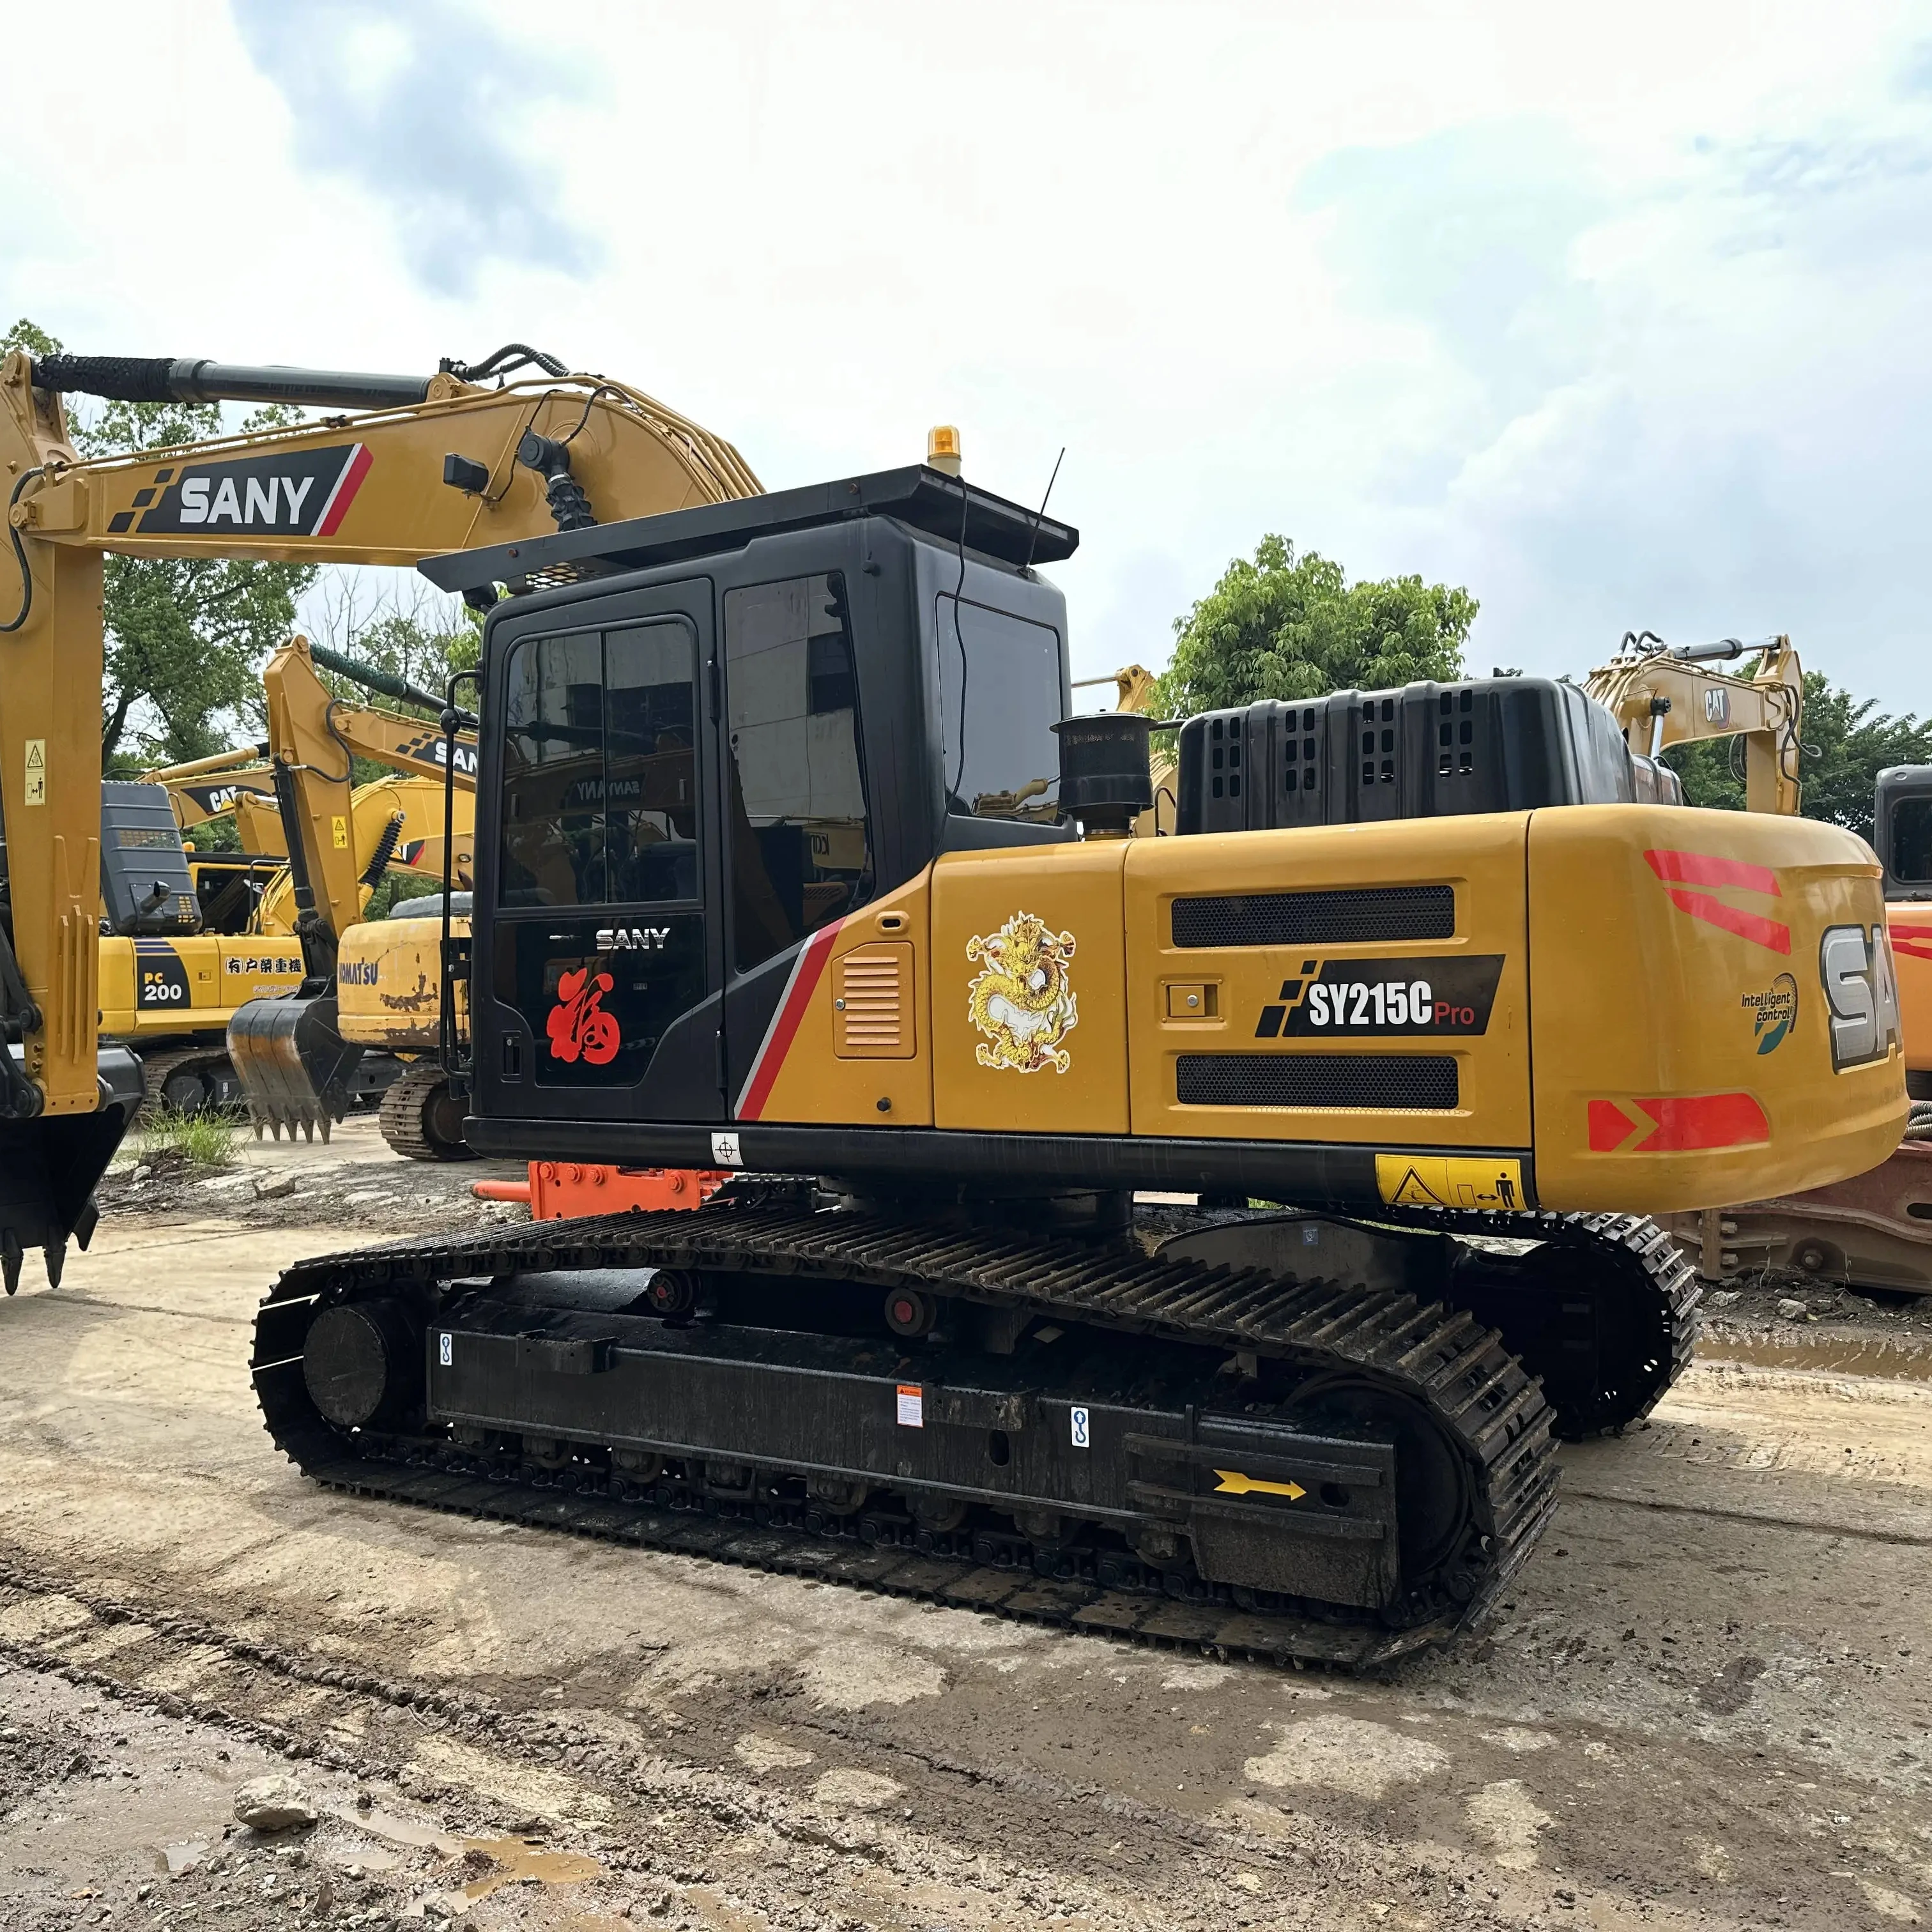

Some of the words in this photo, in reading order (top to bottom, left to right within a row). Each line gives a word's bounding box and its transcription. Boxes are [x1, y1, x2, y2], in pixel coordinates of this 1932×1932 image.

[180, 477, 315, 525] SANY
[1705, 689, 1724, 721] CAT
[210, 786, 236, 813] CAT
[595, 928, 671, 950] SANY
[144, 972, 163, 984] PC
[339, 963, 378, 985] KOMATSU
[144, 985, 182, 1000] 200
[1309, 981, 1432, 1025] SY215C
[1434, 1002, 1475, 1025] Pro
[1741, 991, 1791, 1008] Intelligent
[1756, 1006, 1790, 1022] control
